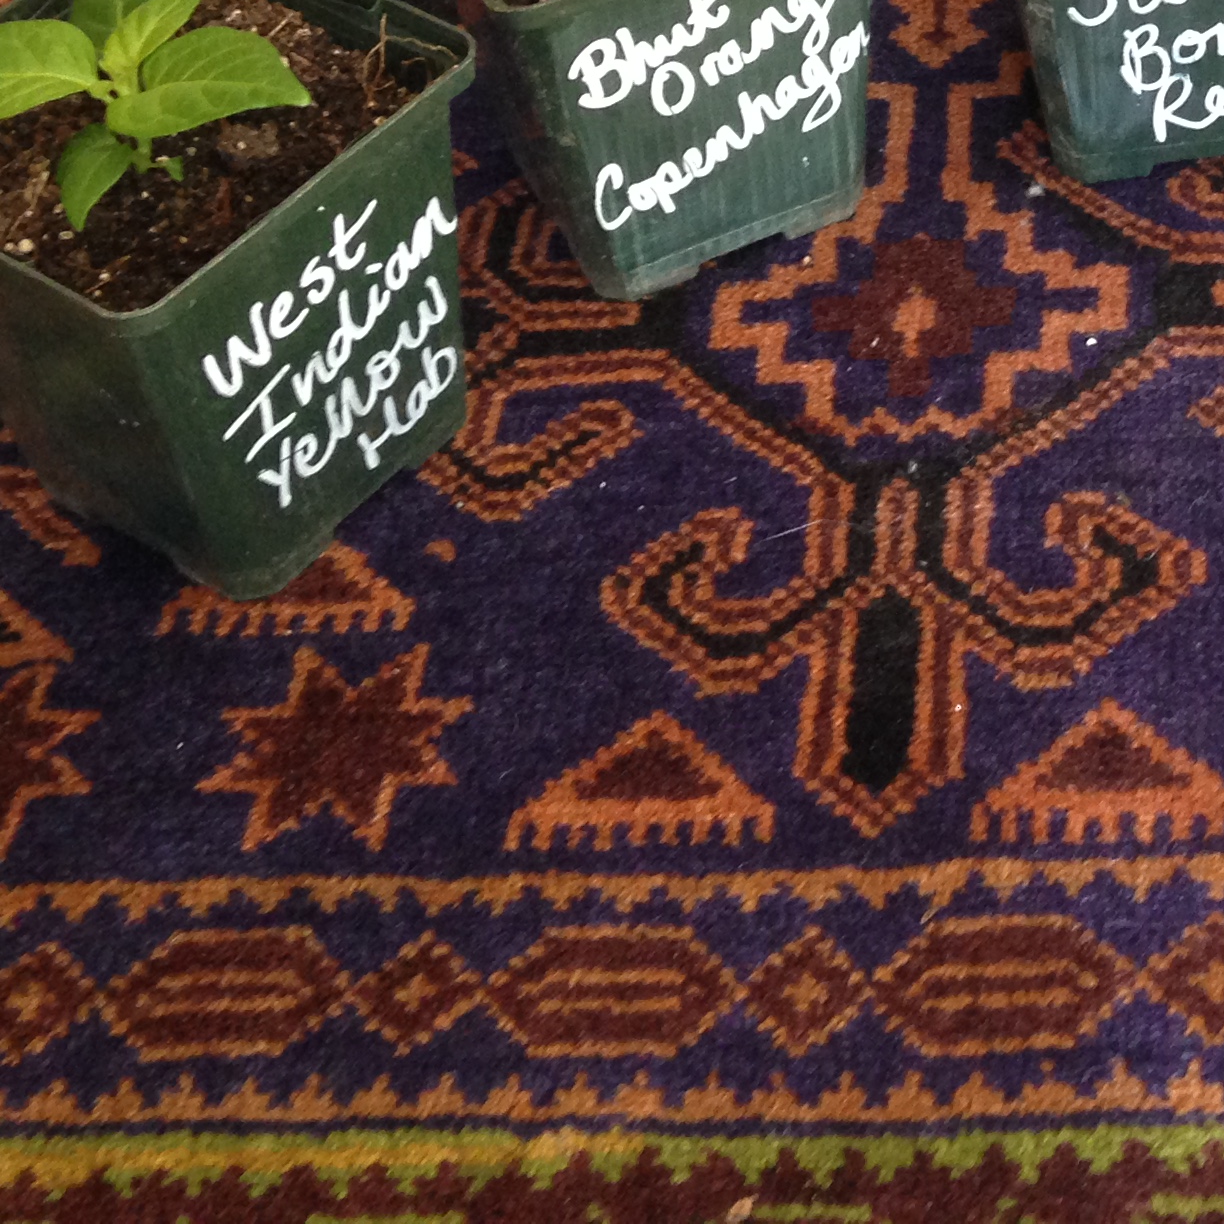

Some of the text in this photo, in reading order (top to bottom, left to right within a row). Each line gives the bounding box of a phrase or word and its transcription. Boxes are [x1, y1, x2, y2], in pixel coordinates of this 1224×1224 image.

[202, 197, 379, 398] West
[222, 195, 458, 464] Indian
[257, 275, 448, 509] Yellow
